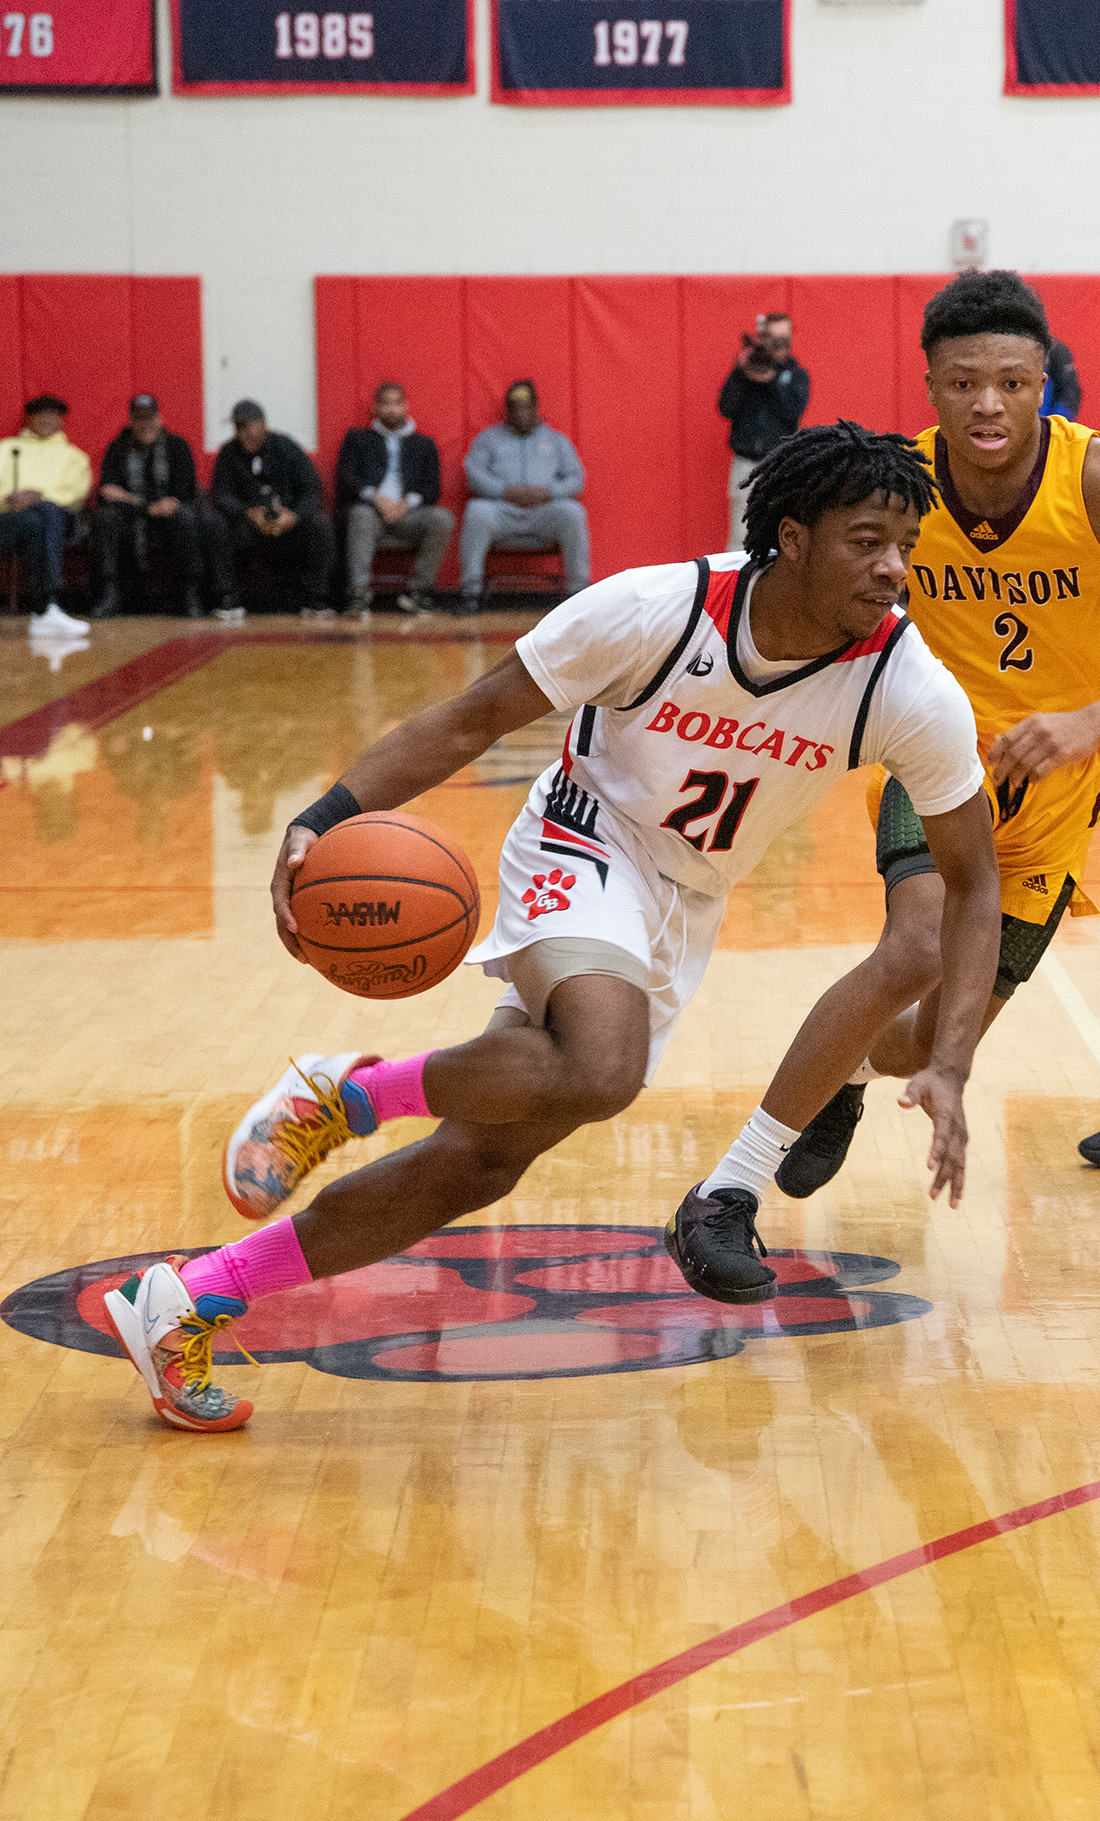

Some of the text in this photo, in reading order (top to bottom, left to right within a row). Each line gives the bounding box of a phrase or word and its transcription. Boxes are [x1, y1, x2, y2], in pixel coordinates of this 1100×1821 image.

[4, 13, 53, 57] 76
[275, 14, 374, 58] 1985
[595, 20, 689, 66] 1977
[969, 531, 999, 541] adidas
[912, 564, 1081, 606] DAVISON
[993, 611, 1034, 672] 2
[644, 701, 835, 772] BOBCATS
[659, 768, 760, 852] 21
[537, 894, 559, 911] GB
[1022, 881, 1048, 894] adidas
